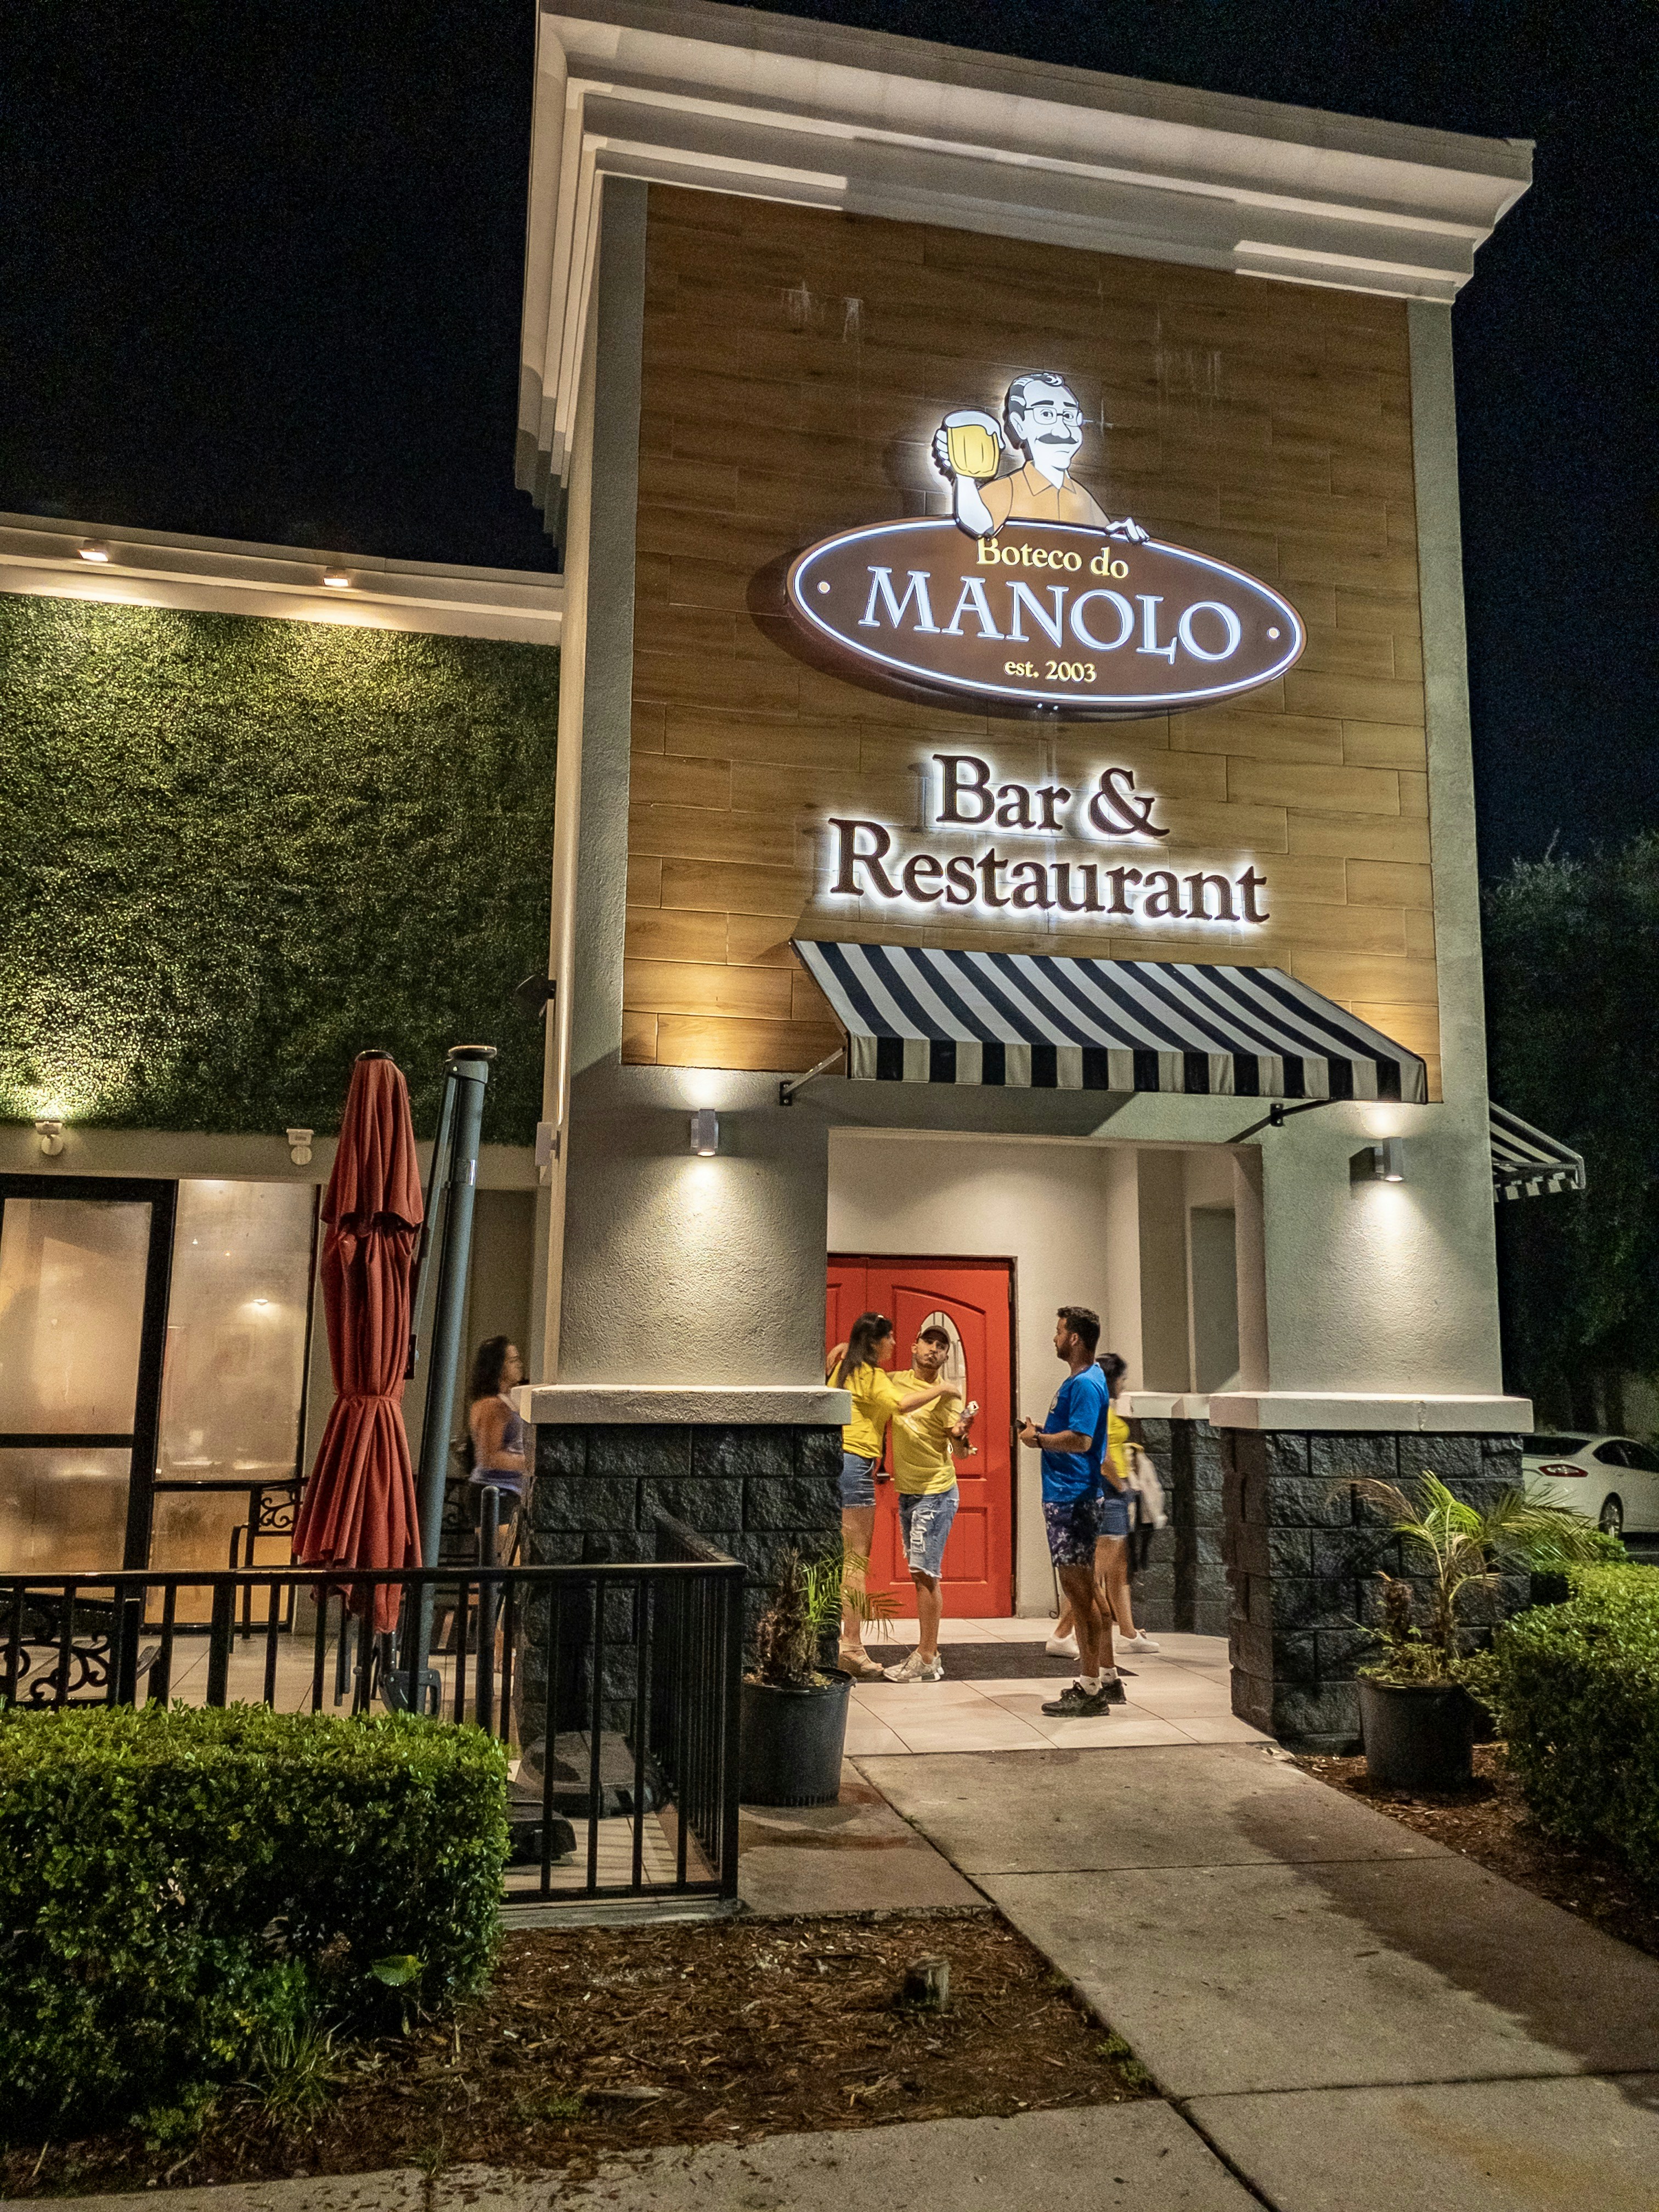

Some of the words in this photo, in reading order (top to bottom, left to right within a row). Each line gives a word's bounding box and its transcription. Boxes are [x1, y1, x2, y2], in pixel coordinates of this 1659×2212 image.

[976, 537, 1082, 572] Boteco
[1090, 546, 1129, 579] do
[858, 565, 1242, 664] MANOLO
[1004, 661, 1039, 678] est.
[1045, 661, 1097, 682] 2003
[932, 753, 1071, 830] Bar
[1088, 768, 1170, 837] &
[828, 817, 1271, 924] Restaurant
